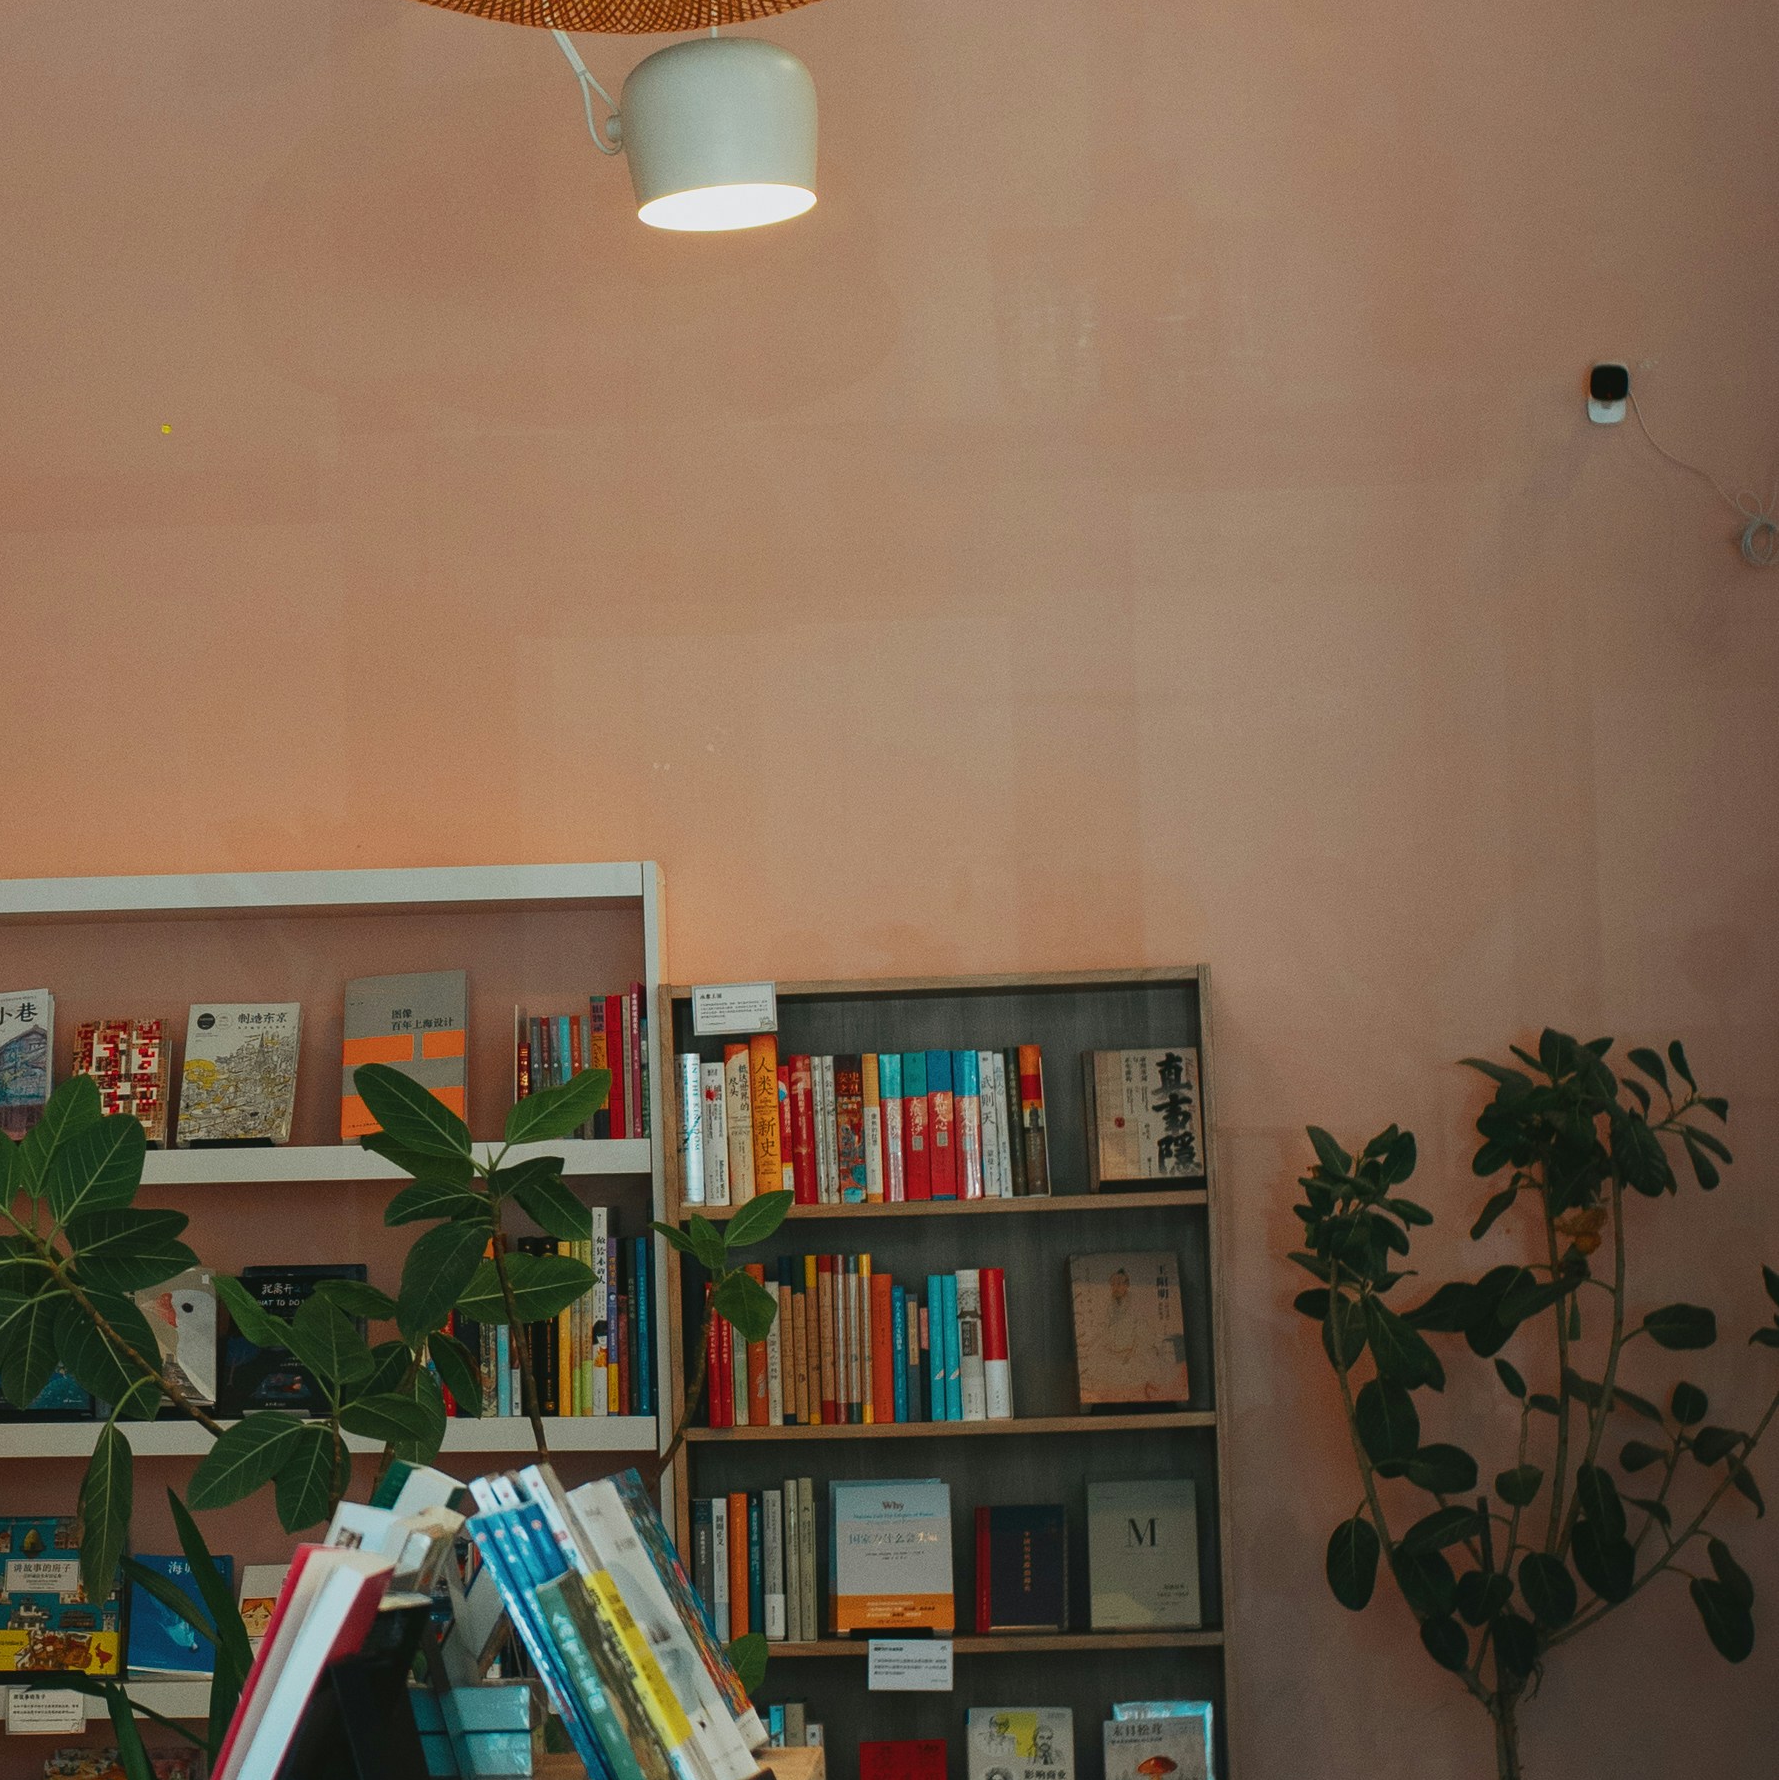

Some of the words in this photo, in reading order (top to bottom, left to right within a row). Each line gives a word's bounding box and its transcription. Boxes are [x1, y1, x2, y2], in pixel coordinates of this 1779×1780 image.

[237, 1012, 288, 1025] 制造东京
[391, 1008, 412, 1020] 图像
[391, 1017, 454, 1031] 百年上海设计
[981, 1074, 995, 1126] 武则天
[756, 1057, 777, 1158] 人类新史
[276, 1299, 286, 1307] TO
[288, 1299, 300, 1307] DO
[881, 1500, 905, 1512] Why
[1124, 1518, 1159, 1548] M
[13, 1562, 73, 1573] 讲故事的房子
[1024, 1769, 1067, 1780] 影响商业
